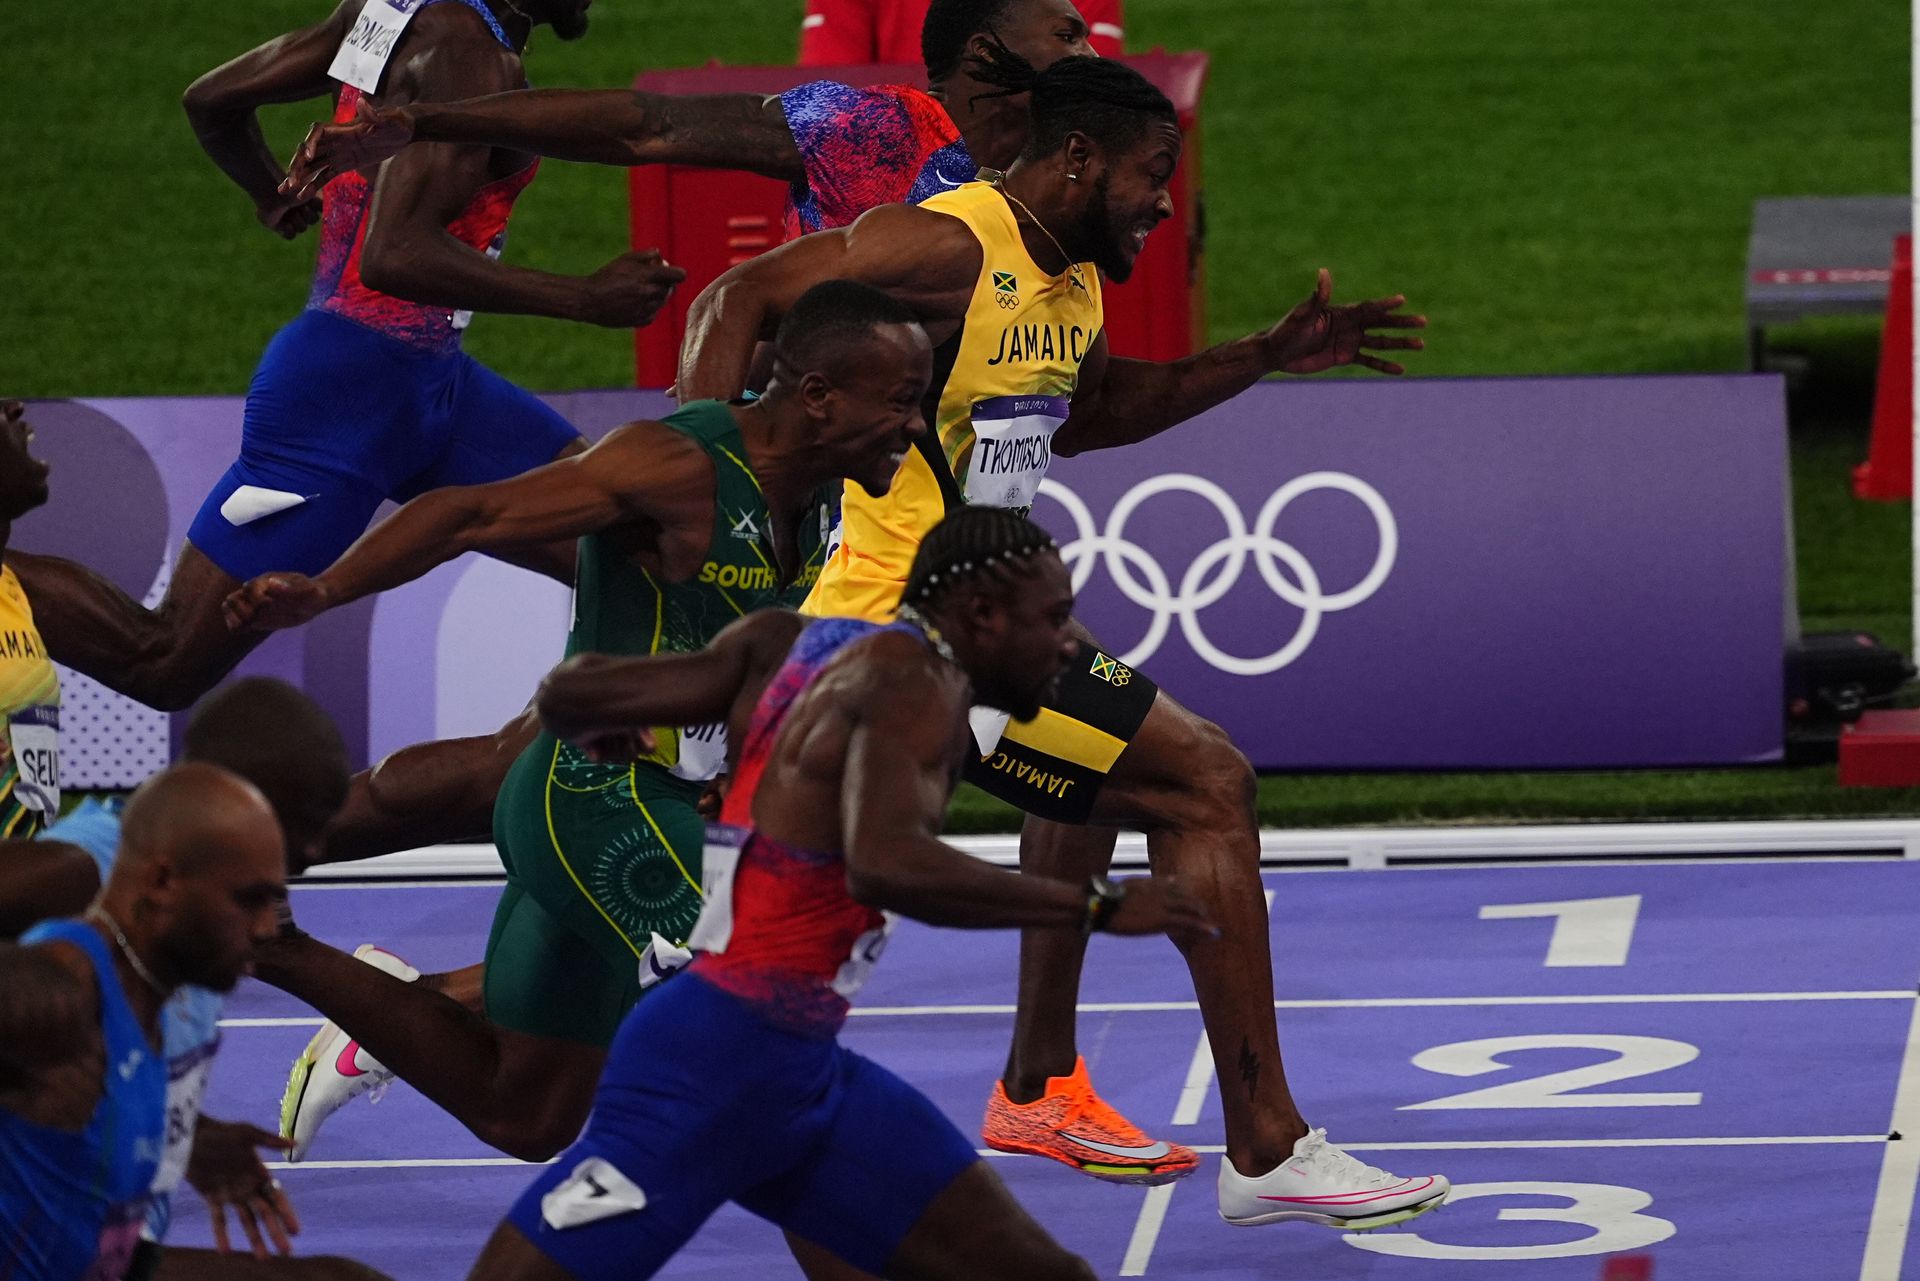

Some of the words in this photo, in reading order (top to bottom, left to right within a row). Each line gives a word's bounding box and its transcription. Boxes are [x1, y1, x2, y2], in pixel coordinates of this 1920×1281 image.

[979, 434, 1050, 475] THOMPSON
[698, 560, 776, 590] SOUTH
[1478, 894, 1643, 967] 1
[1394, 1034, 1703, 1111] 2
[1342, 1181, 1677, 1261] 3
